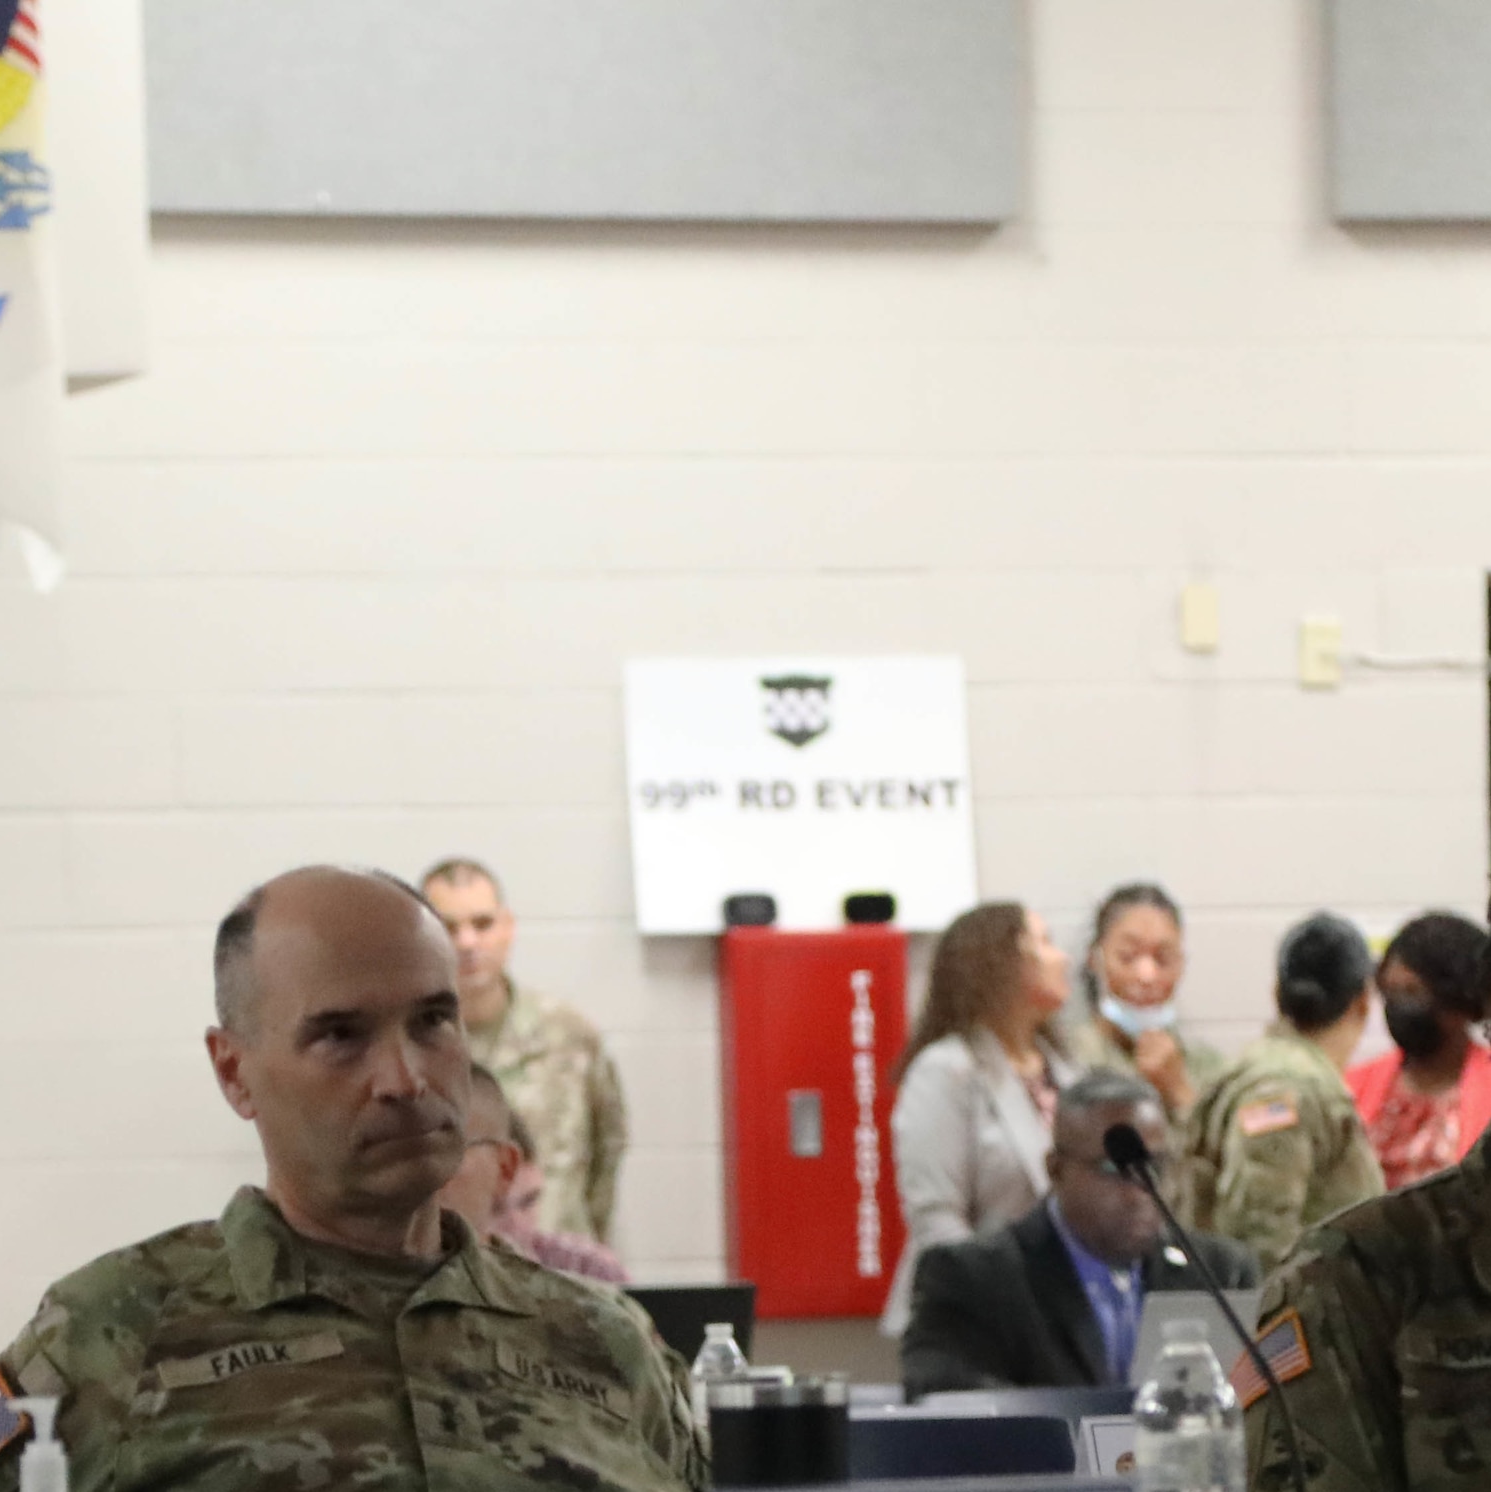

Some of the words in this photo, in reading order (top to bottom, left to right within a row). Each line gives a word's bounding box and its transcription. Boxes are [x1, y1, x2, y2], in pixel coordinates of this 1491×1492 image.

[738, 779, 797, 810] RD
[815, 778, 962, 810] EVENT
[210, 1345, 293, 1378] FAULK
